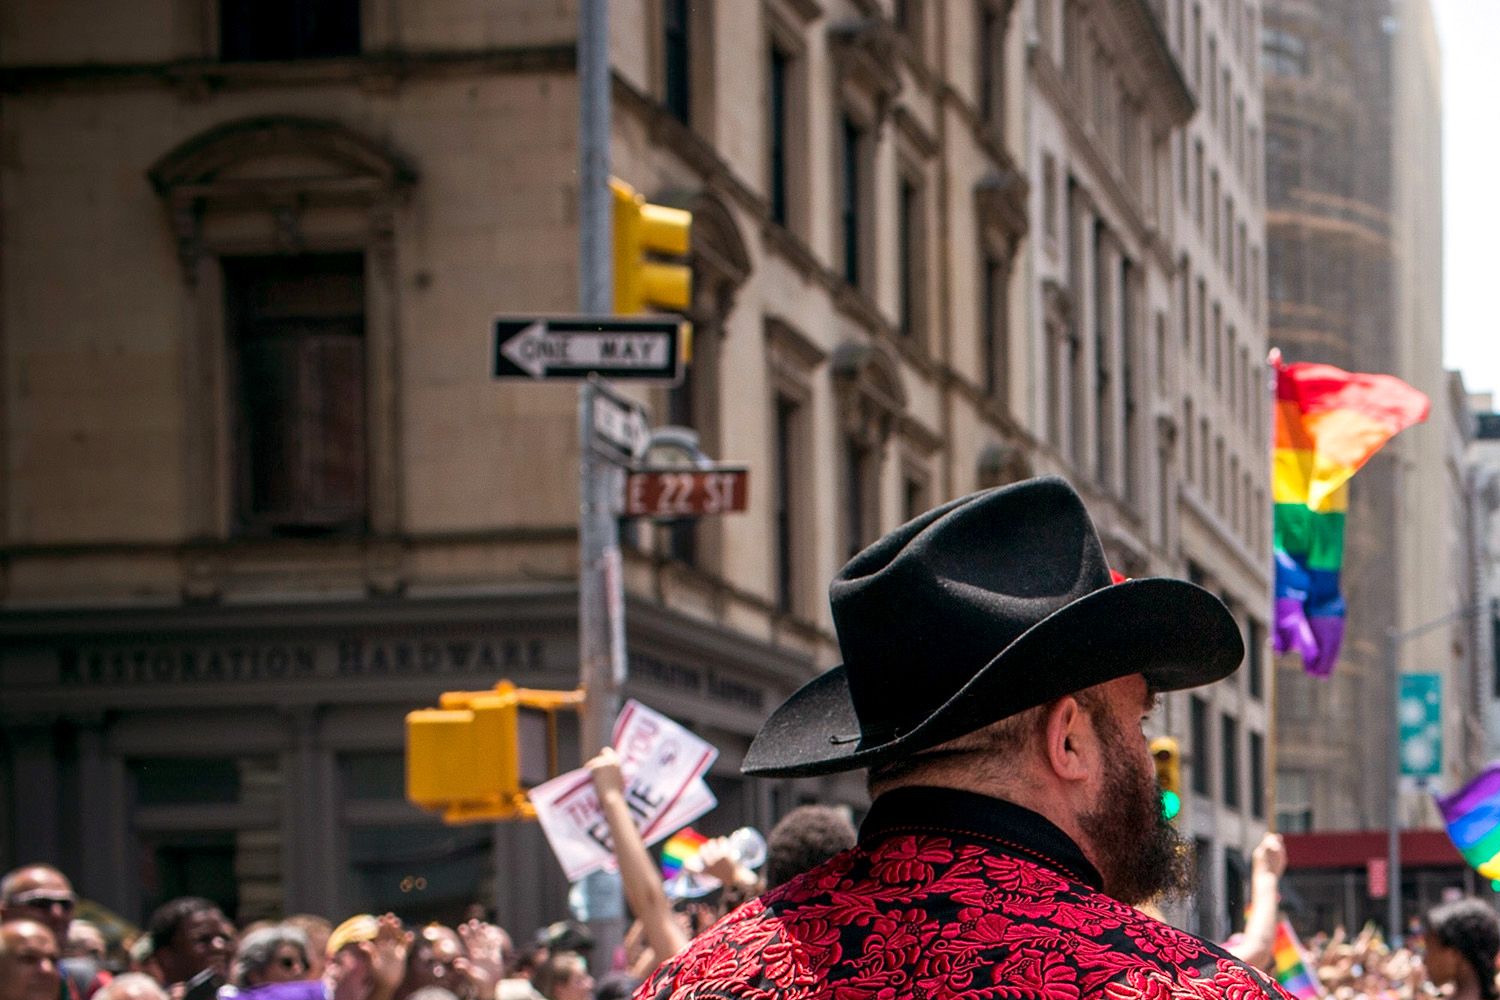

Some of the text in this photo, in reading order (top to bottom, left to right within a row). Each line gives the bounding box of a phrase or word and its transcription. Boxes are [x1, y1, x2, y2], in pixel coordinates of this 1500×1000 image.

[520, 336, 655, 360] ONE WAY
[630, 474, 734, 512] E 22 ST
[59, 639, 544, 683] RESTORATION HARDWARE
